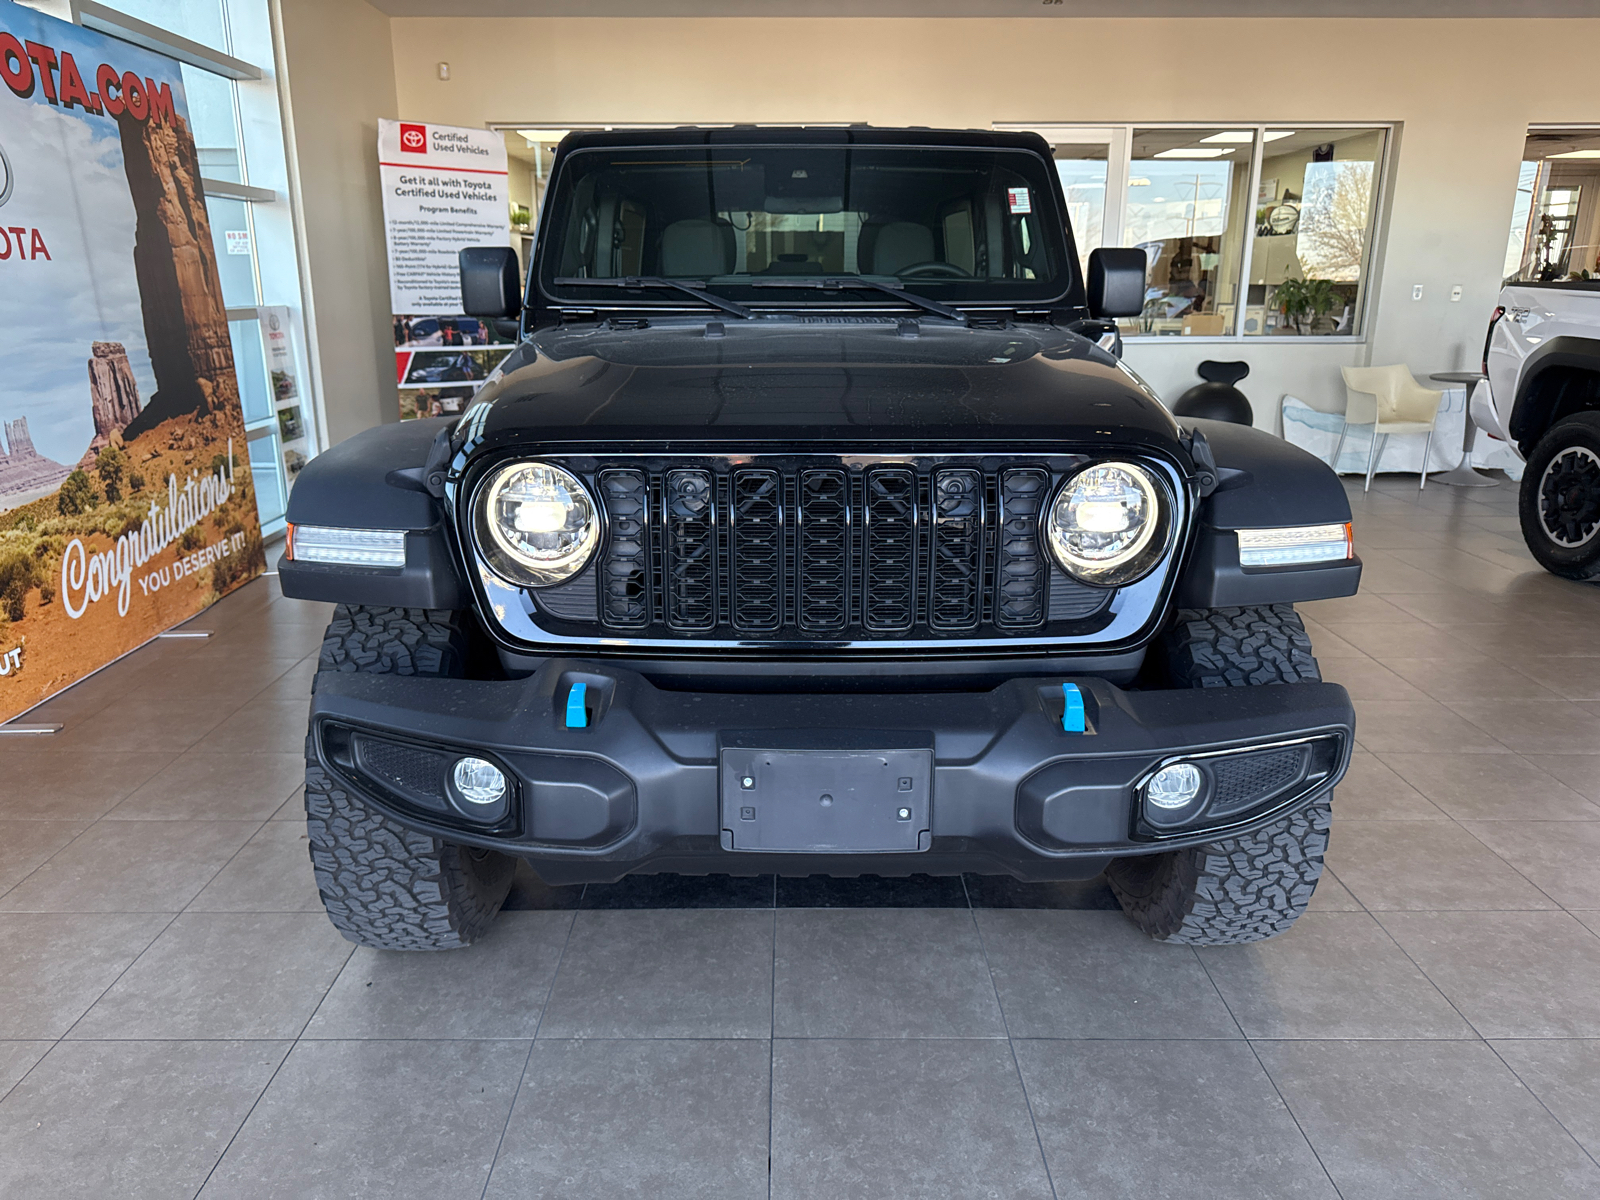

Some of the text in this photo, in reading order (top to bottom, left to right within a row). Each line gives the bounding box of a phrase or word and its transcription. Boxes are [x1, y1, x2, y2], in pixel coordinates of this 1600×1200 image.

[432, 131, 468, 143] Certified
[433, 142, 489, 155] Used Vehicles
[400, 175, 492, 191] Get it all with Toyota
[395, 187, 497, 201] Certified Used Vehicles
[419, 205, 478, 215] Program Benefits
[62, 437, 236, 619] Congratulations!
[138, 530, 246, 596] YOU DESERVE IT!
